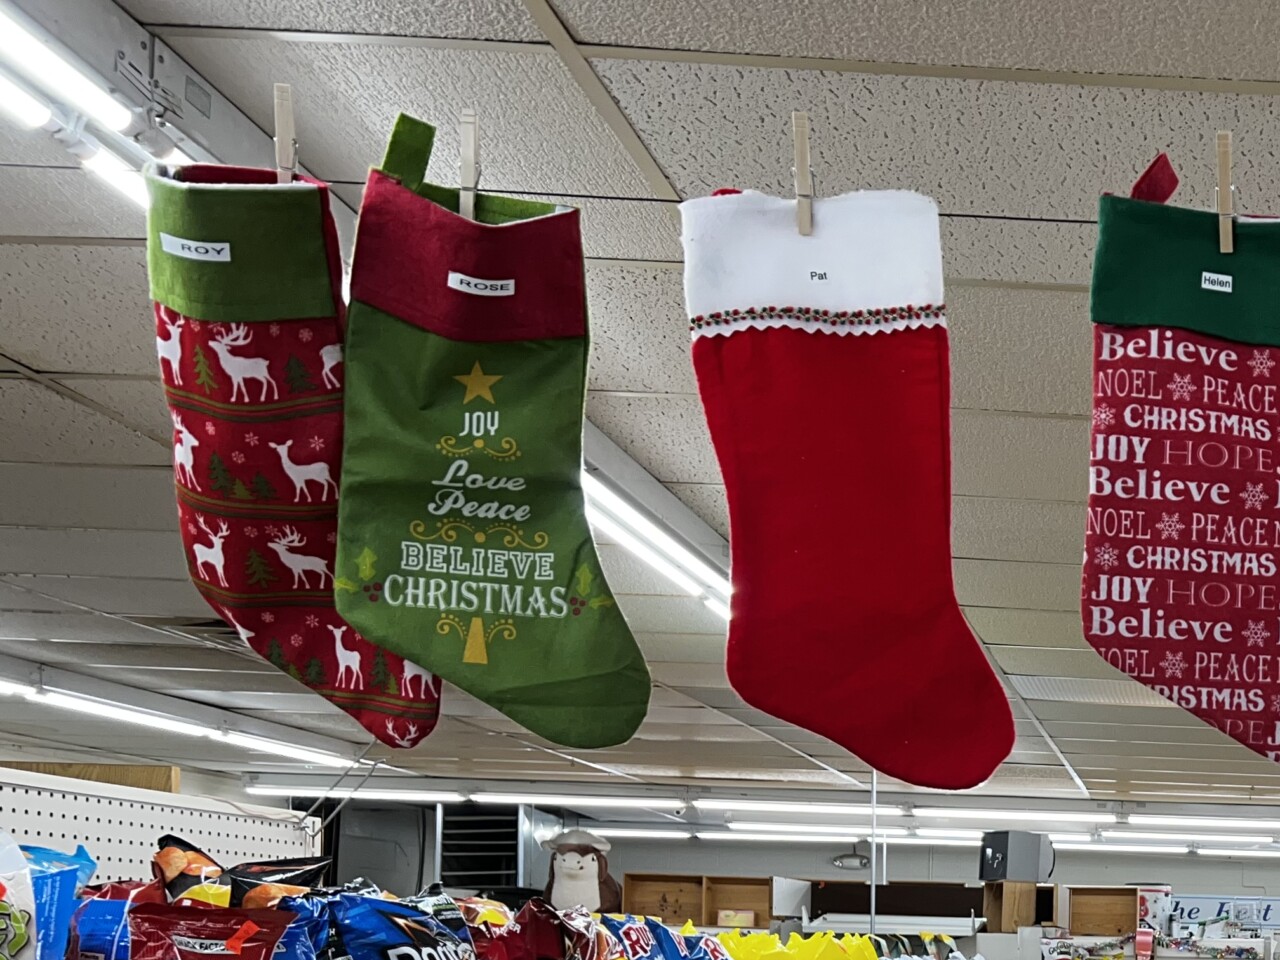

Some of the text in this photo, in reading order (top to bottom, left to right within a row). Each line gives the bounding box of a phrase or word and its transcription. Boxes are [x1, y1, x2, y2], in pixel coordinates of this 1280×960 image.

[181, 243, 225, 256] ROY
[459, 277, 511, 292] ROSE
[810, 271, 828, 281] Pat
[1203, 275, 1231, 288] Helen
[1100, 330, 1238, 371] Believe
[1098, 369, 1163, 400] NOEL
[1203, 375, 1277, 415] PEACE
[459, 411, 501, 437] JOY
[1123, 404, 1272, 442] CHRISTMAS
[1090, 434, 1273, 472] JOY HOPE
[432, 460, 527, 492] Love
[1089, 467, 1231, 505] Believe
[427, 488, 531, 523] Peace
[1087, 508, 1268, 548] NOEL PEACE
[401, 541, 554, 581] BELIEVE
[1127, 545, 1277, 578] CHRISTMAS
[383, 574, 569, 619] CHRISTMAS
[1091, 574, 1154, 604] JOY
[1167, 578, 1277, 610] HOPE
[1089, 605, 1233, 642] Believe
[1194, 651, 1271, 683] PEACE
[1147, 684, 1265, 712] RISTMAS
